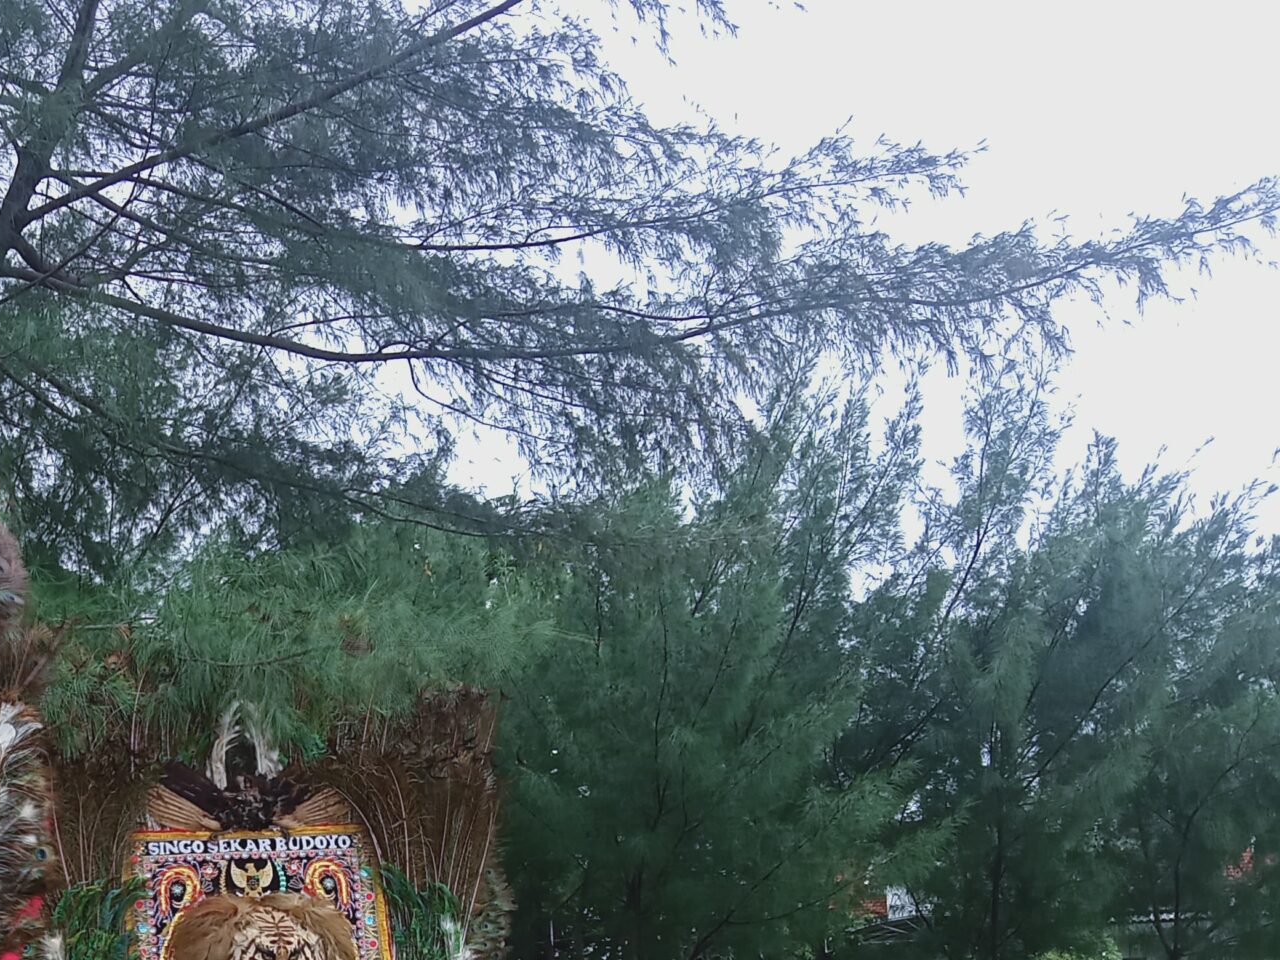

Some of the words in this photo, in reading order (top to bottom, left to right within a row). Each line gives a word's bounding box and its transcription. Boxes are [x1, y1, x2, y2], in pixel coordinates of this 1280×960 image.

[147, 839, 205, 856] SINGO
[207, 837, 271, 853] SEKAR
[275, 834, 351, 852] BUDOYO
